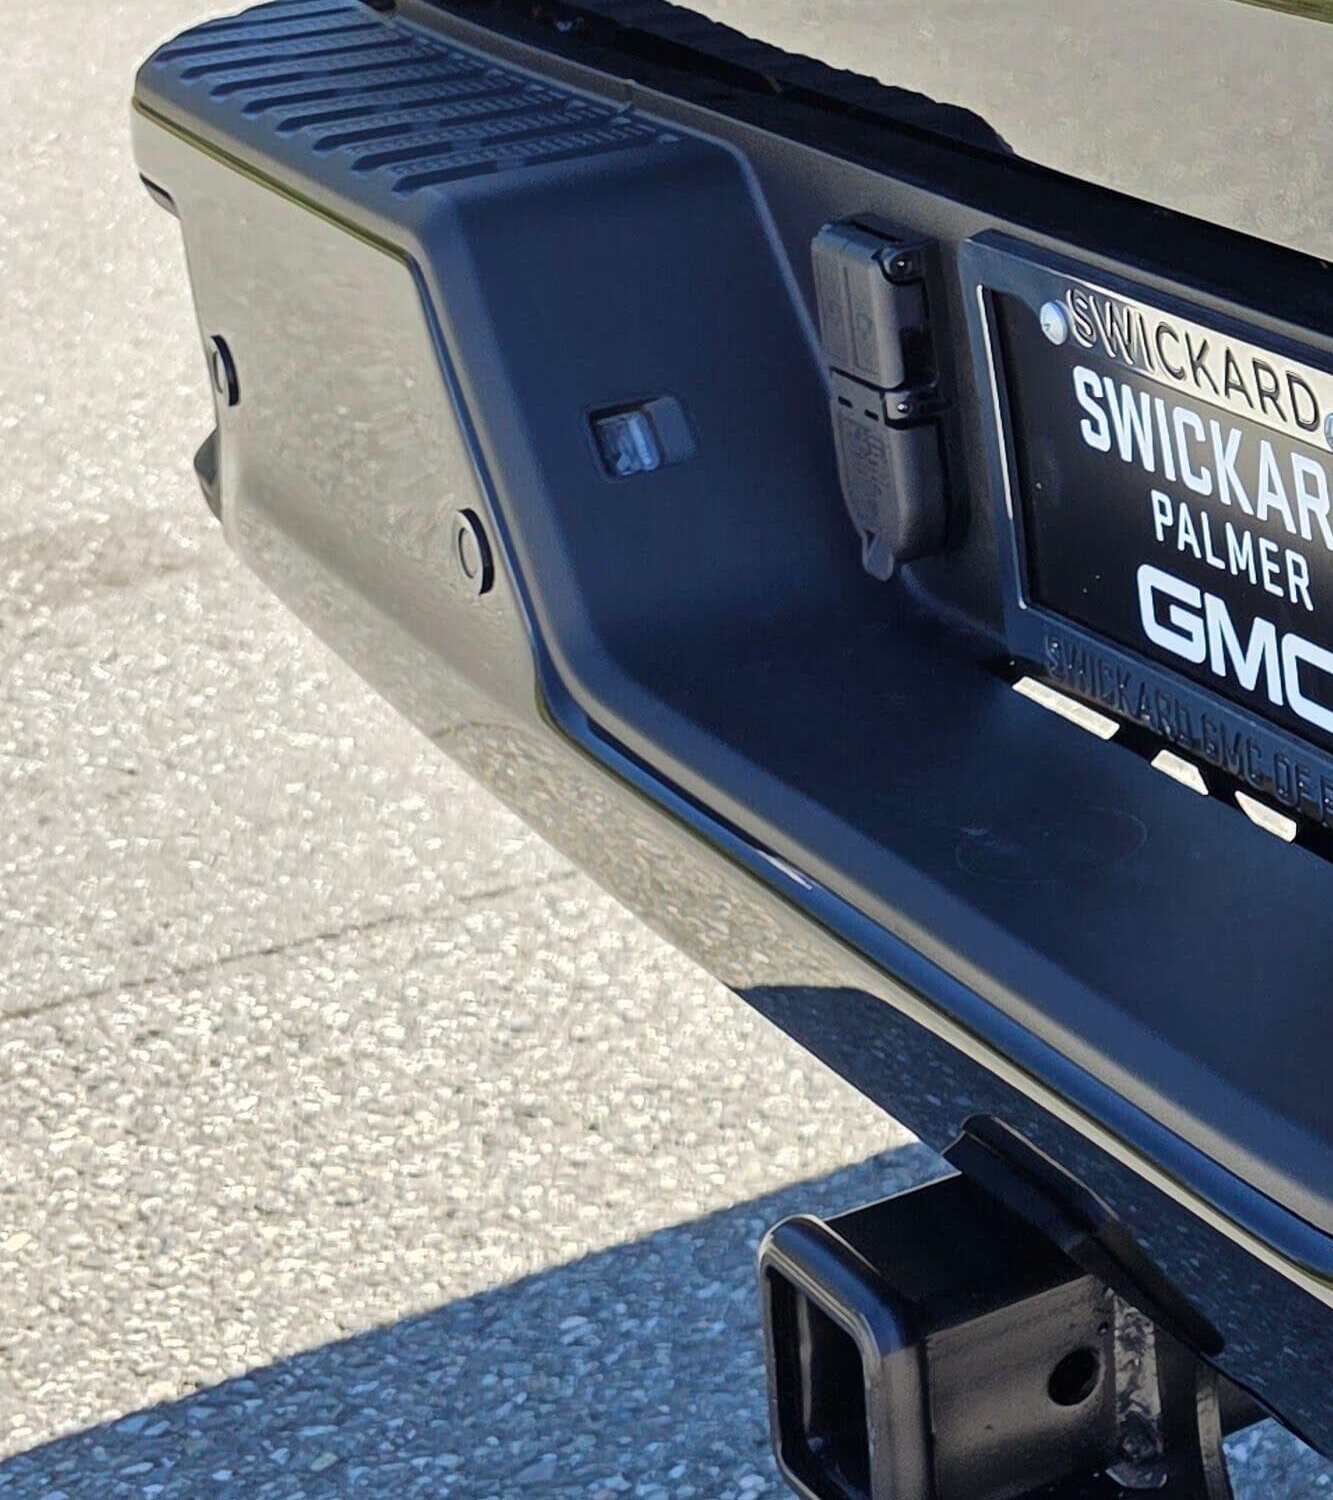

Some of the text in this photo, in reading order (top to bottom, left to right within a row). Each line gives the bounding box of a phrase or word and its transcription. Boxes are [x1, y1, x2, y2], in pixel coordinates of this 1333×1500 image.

[1066, 288, 1320, 432] SWICKARD
[1151, 489, 1314, 611] PALMER
[1043, 633, 1193, 750] SWICKARD
[1200, 711, 1268, 792] GMC
[1273, 750, 1311, 813] OF
